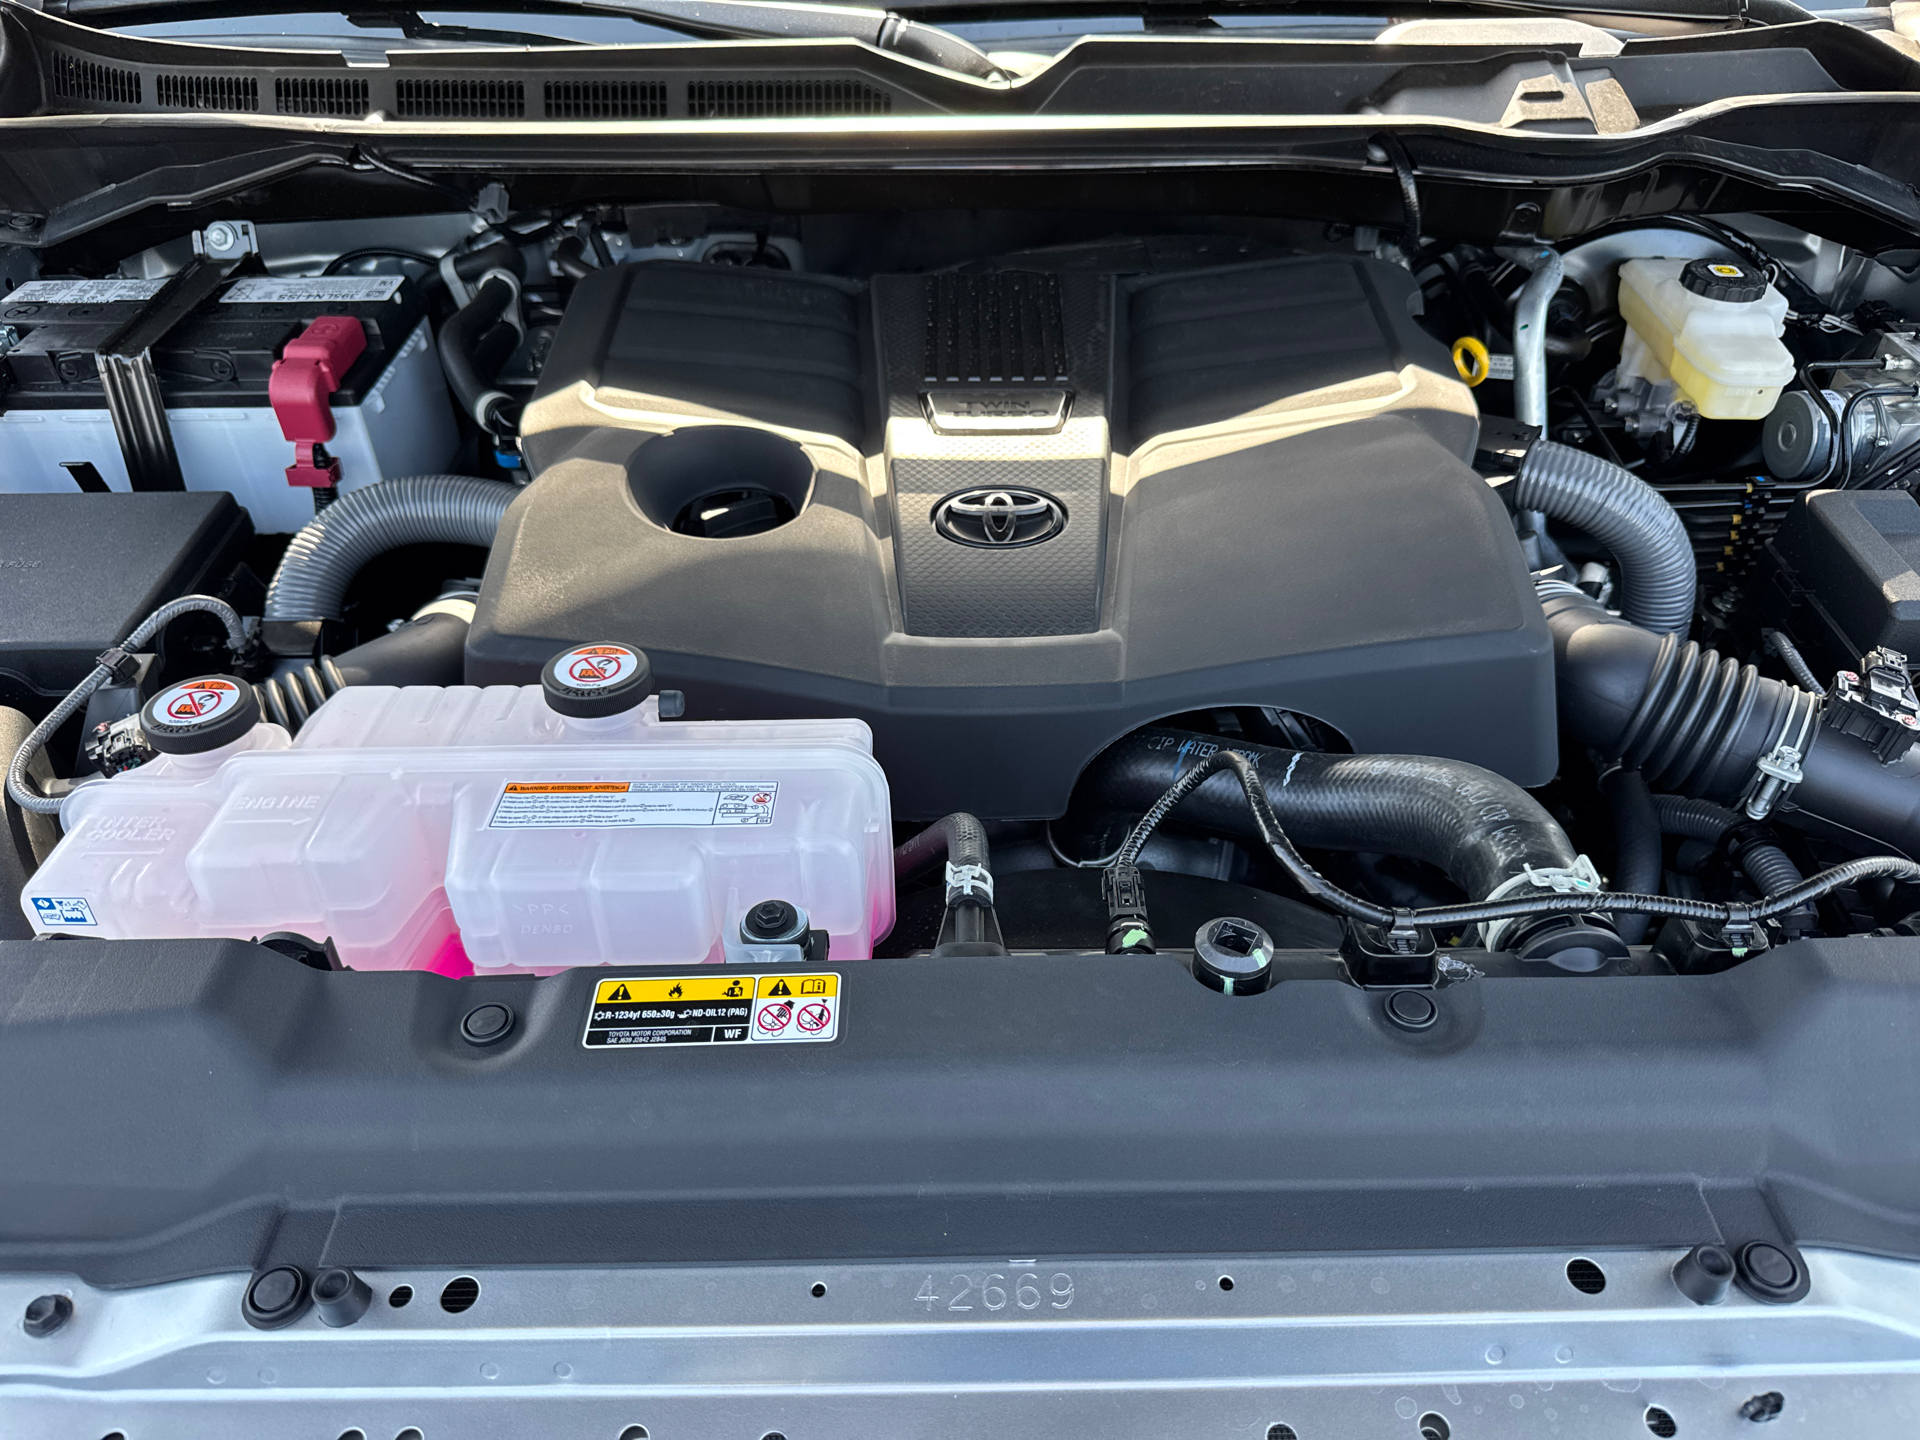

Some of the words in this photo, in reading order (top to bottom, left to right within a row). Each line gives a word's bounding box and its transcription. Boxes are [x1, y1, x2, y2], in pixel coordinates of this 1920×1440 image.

[959, 401, 1030, 410] TWIN
[232, 795, 321, 810] ENGINE
[94, 815, 167, 829] INTER
[86, 828, 177, 842] COOLER
[520, 924, 574, 935] DENSO
[605, 1010, 641, 1020] R-1234yf
[641, 1009, 676, 1019] 650±30g
[727, 1007, 748, 1018] (PAG)
[724, 1029, 742, 1039] WF
[914, 1272, 1075, 1311] 42669
